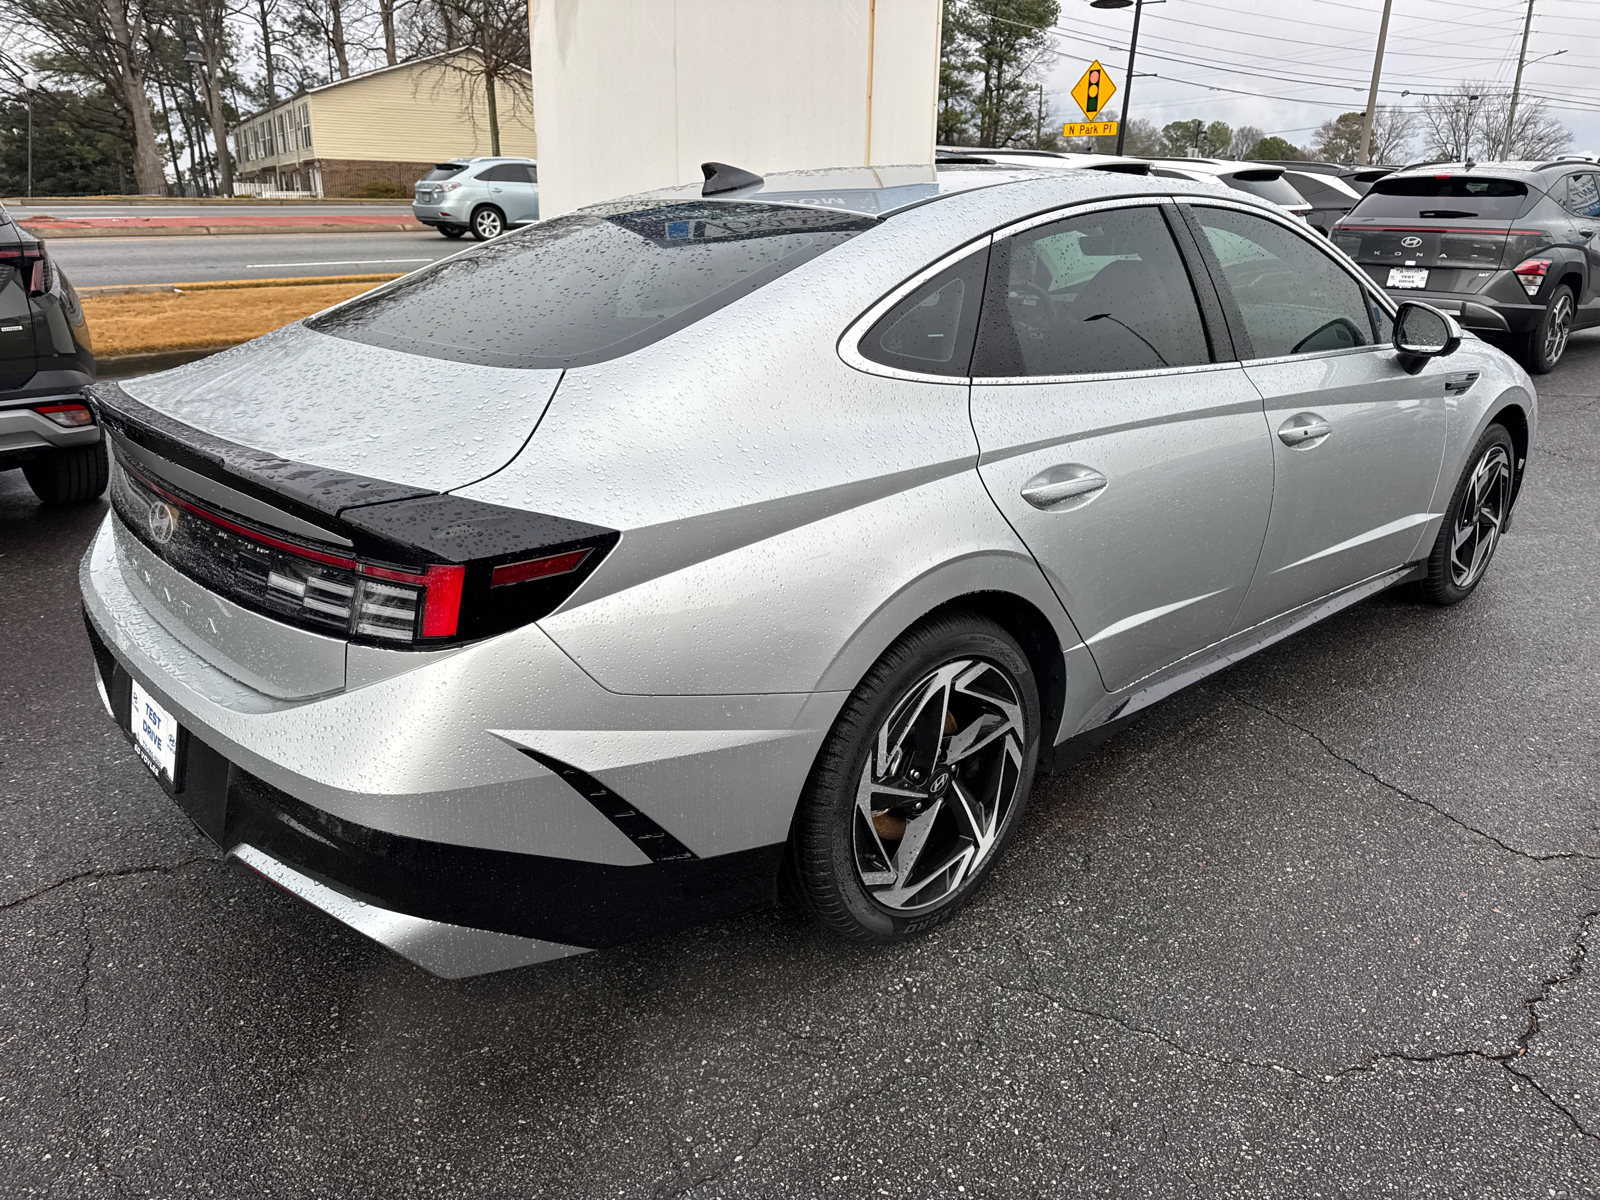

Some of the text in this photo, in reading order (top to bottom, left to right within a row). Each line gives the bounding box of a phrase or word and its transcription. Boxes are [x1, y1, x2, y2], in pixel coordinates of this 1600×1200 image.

[1069, 124, 1112, 135] N Park Pl
[1373, 250, 1448, 259] KONA
[145, 702, 161, 730] TEST
[142, 719, 162, 751] DRIVE
